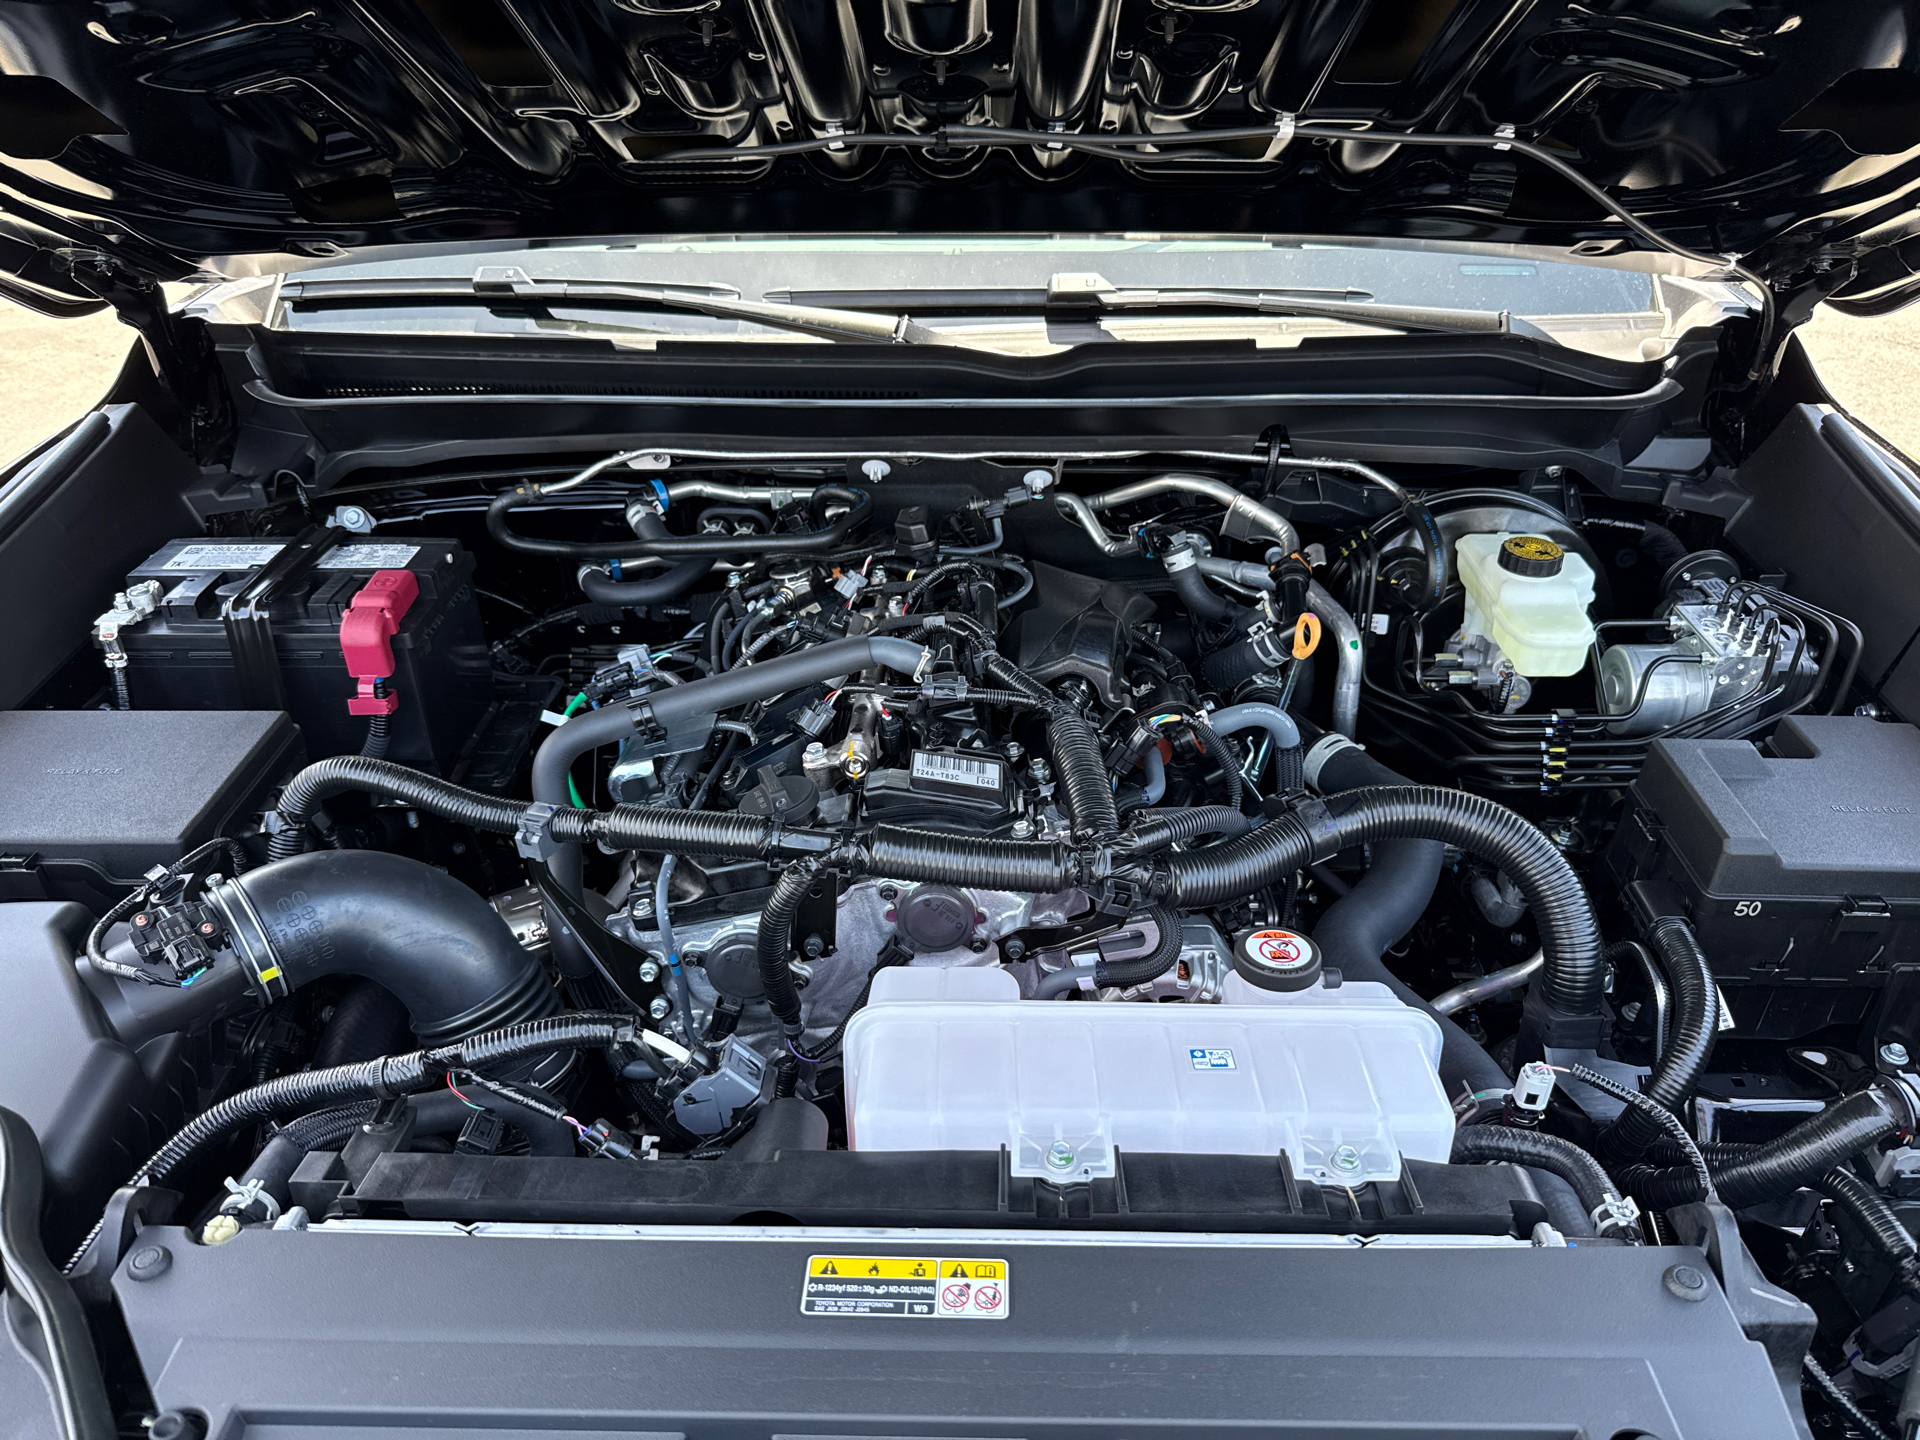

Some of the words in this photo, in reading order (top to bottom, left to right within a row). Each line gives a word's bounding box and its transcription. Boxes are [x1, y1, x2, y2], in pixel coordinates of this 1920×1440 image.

[46, 768, 83, 776] RELAY
[93, 768, 124, 776] FUSE
[916, 768, 960, 781] T24A-T83C
[980, 778, 996, 786] 040
[1830, 805, 1869, 813] RELAY
[1881, 806, 1916, 815] FUSE
[1733, 900, 1762, 917] 50
[817, 1283, 846, 1293] R-1234yf
[913, 1304, 929, 1313] W9
